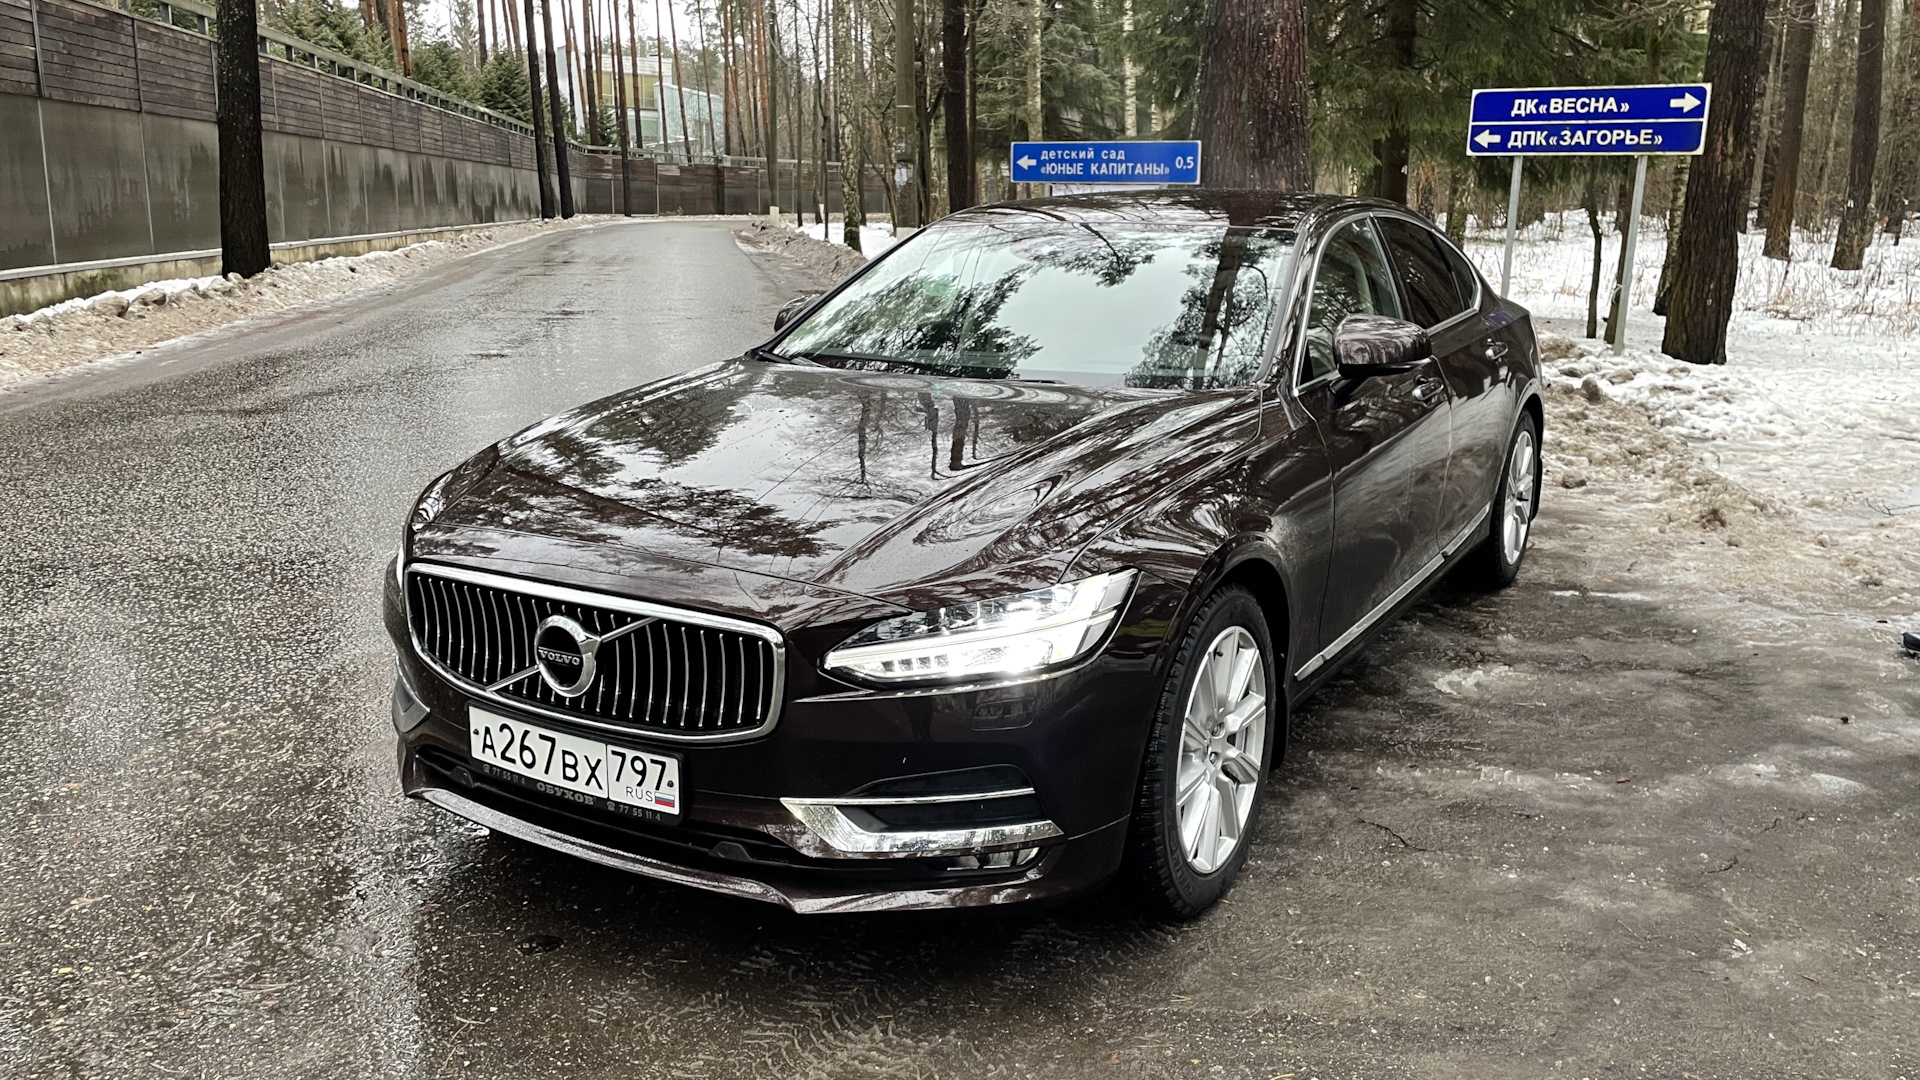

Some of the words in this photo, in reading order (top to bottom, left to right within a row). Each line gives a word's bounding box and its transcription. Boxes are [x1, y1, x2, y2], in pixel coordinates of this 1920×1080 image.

[1041, 148, 1095, 160] детский
[1101, 150, 1125, 160] сад
[1040, 163, 1084, 175] «ЮНЫЕ
[1090, 163, 1170, 175] КАПИТАНЫ»
[1175, 156, 1195, 170] 0,5
[538, 649, 580, 665] VOLVO
[610, 750, 667, 791] 797
[536, 782, 594, 805] ОБУХОВ
[625, 786, 653, 802] RUS
